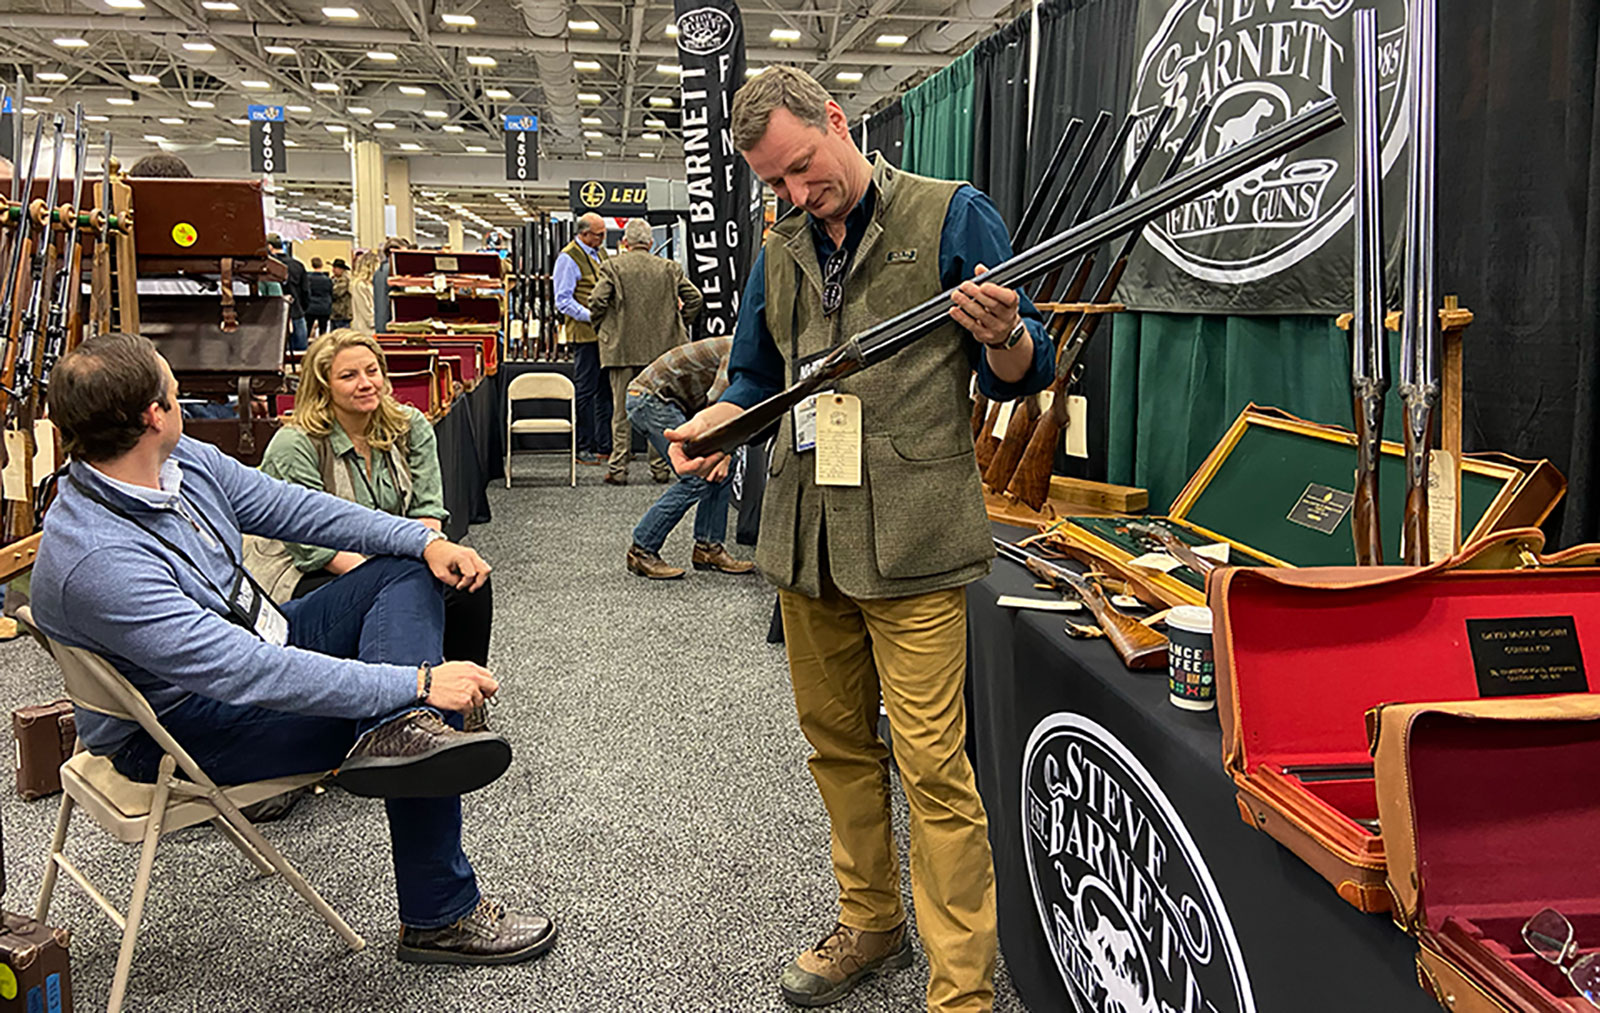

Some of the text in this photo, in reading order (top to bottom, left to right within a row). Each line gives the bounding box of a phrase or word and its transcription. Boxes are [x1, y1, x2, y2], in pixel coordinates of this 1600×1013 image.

[1160, 20, 1344, 150] BARNETT
[262, 122, 274, 172] 4600
[517, 132, 527, 179] 4500
[680, 64, 716, 223] BARNETT
[610, 188, 647, 203] LEU
[1171, 183, 1317, 234] FINE GUNS
[1066, 742, 1167, 889] STEVE
